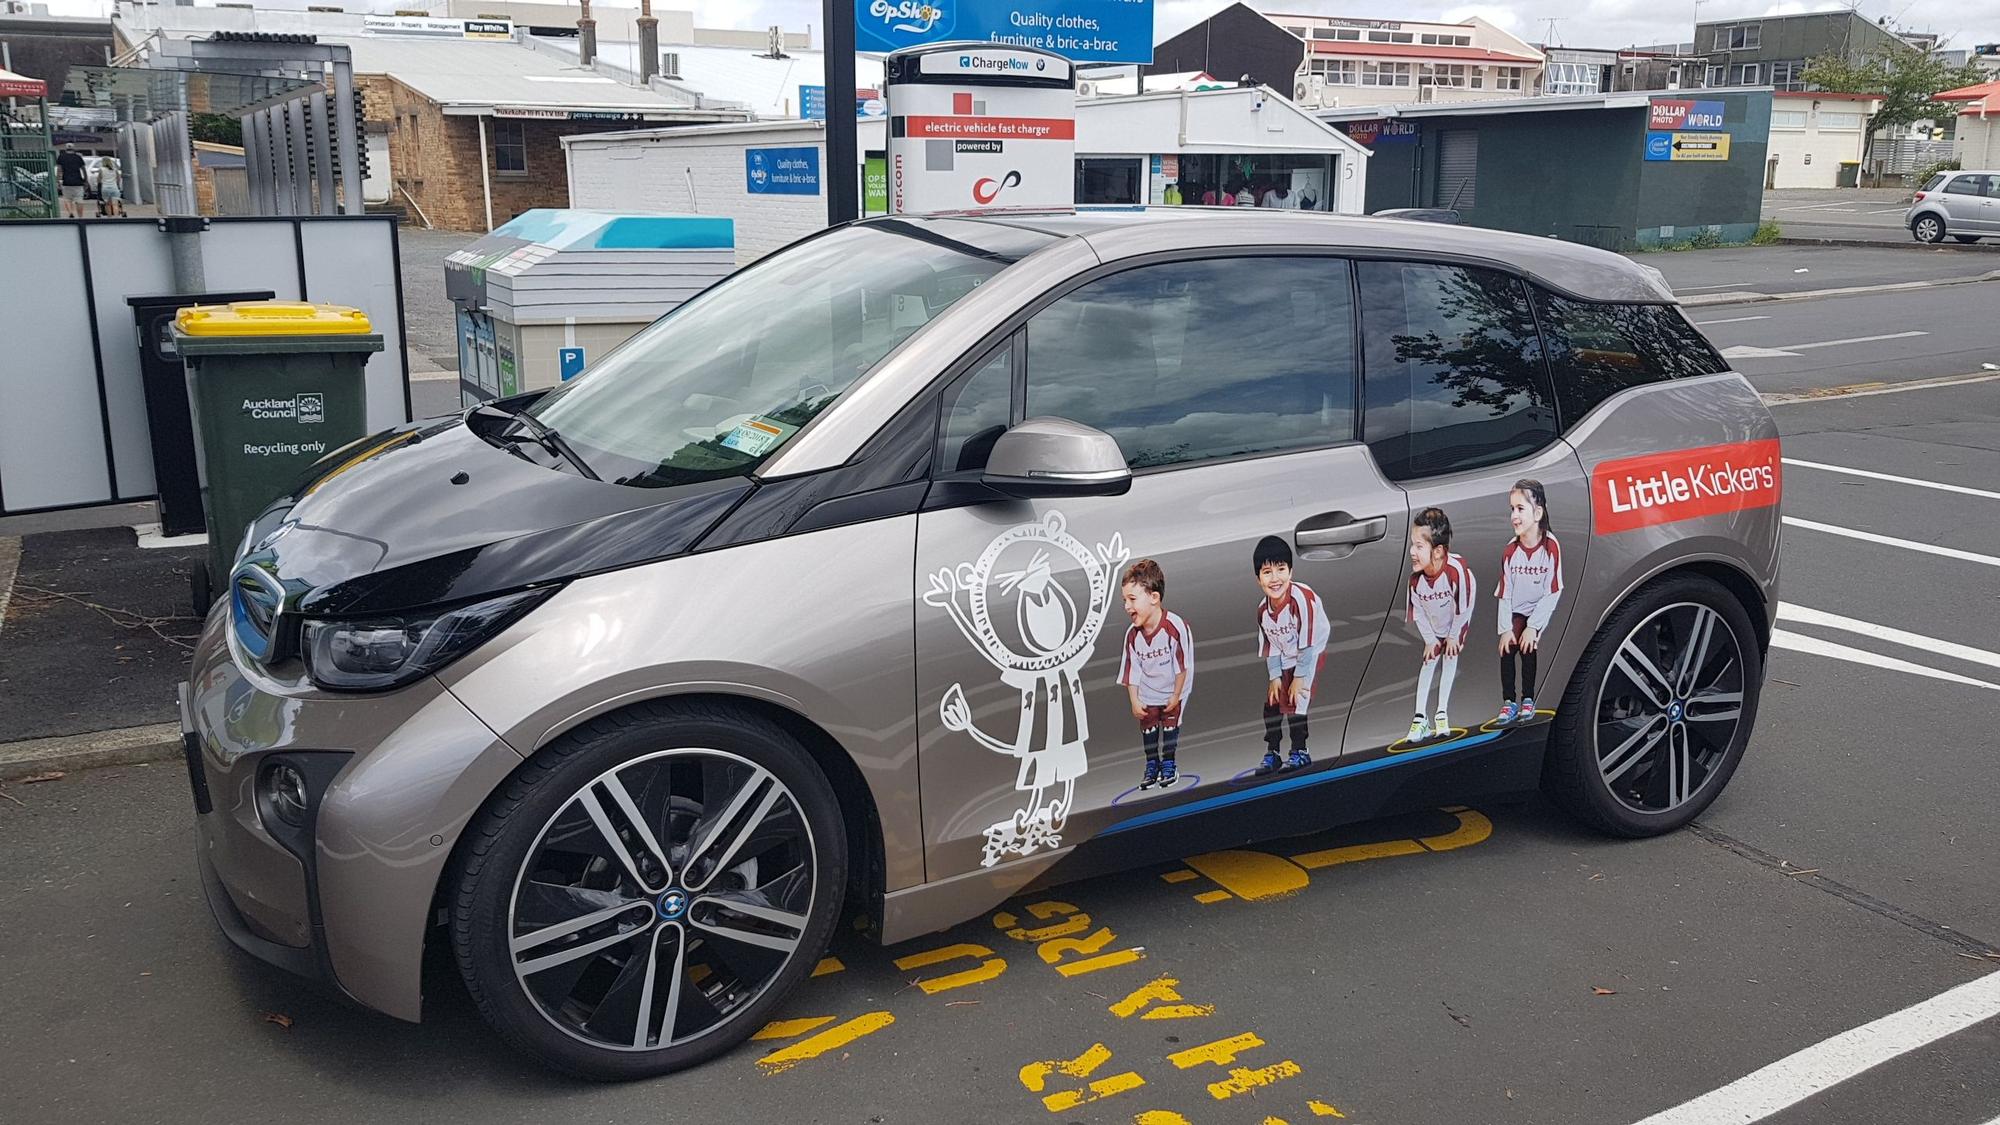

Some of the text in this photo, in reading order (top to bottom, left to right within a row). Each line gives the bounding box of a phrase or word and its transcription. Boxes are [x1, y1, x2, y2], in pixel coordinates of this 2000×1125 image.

[1010, 11, 1100, 30] Quality clothes,
[990, 31, 1118, 51] furniture & bric-a-brac
[971, 56, 1029, 71] ChargeNow
[1651, 116, 1674, 124] PHOTO
[1652, 105, 1723, 127] DOLLAR WORLD
[925, 122, 1050, 136] electric vehicle fast charger
[1348, 123, 1415, 135] DOLLAR WORLD
[956, 142, 1001, 152] powered by
[776, 159, 792, 171] Quality
[1345, 163, 1353, 180] 5
[895, 154, 903, 213] er.com
[565, 352, 577, 364] P
[242, 398, 296, 410] Auckland
[252, 408, 297, 419] Council
[243, 441, 326, 457] Recycling only
